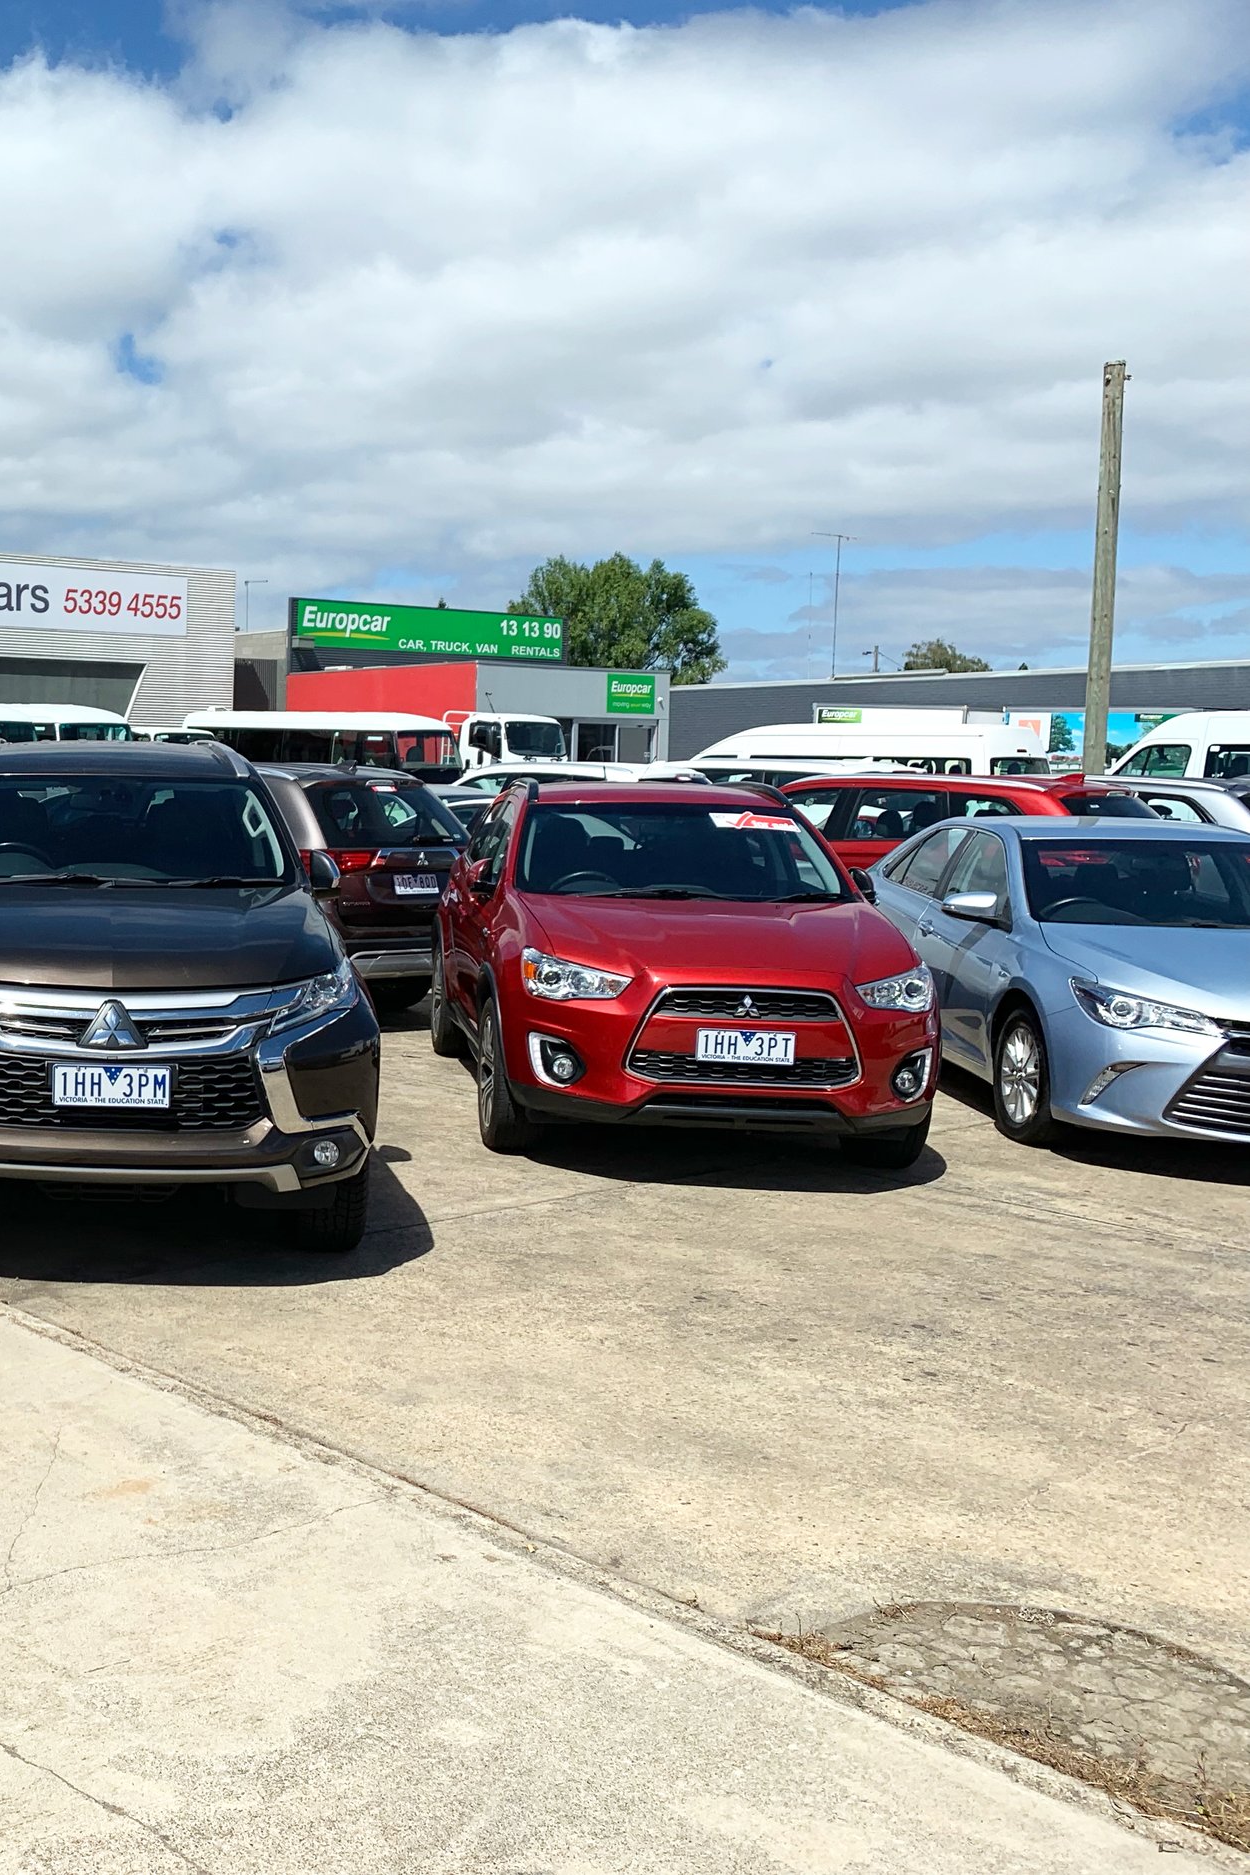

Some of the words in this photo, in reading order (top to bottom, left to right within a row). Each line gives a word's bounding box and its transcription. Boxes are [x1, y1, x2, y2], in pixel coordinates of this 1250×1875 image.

[63, 588, 122, 616] 5339
[126, 593, 182, 619] 4555
[302, 605, 391, 637] Europcar
[500, 619, 518, 636] 13
[522, 621, 540, 637] 13
[543, 623, 561, 639] 90
[398, 638, 427, 651] CAR,
[430, 640, 472, 653] TRUCK,
[475, 643, 498, 654] VAN
[511, 645, 560, 657] RENTALS
[611, 681, 652, 697] Europcar
[822, 709, 858, 720] Europcar
[703, 1034, 738, 1055] 1HH
[754, 1037, 791, 1057] 3PT
[61, 1072, 102, 1097] 1HH
[122, 1073, 166, 1098] 3PM
[108, 1097, 145, 1105] EDUCATION
